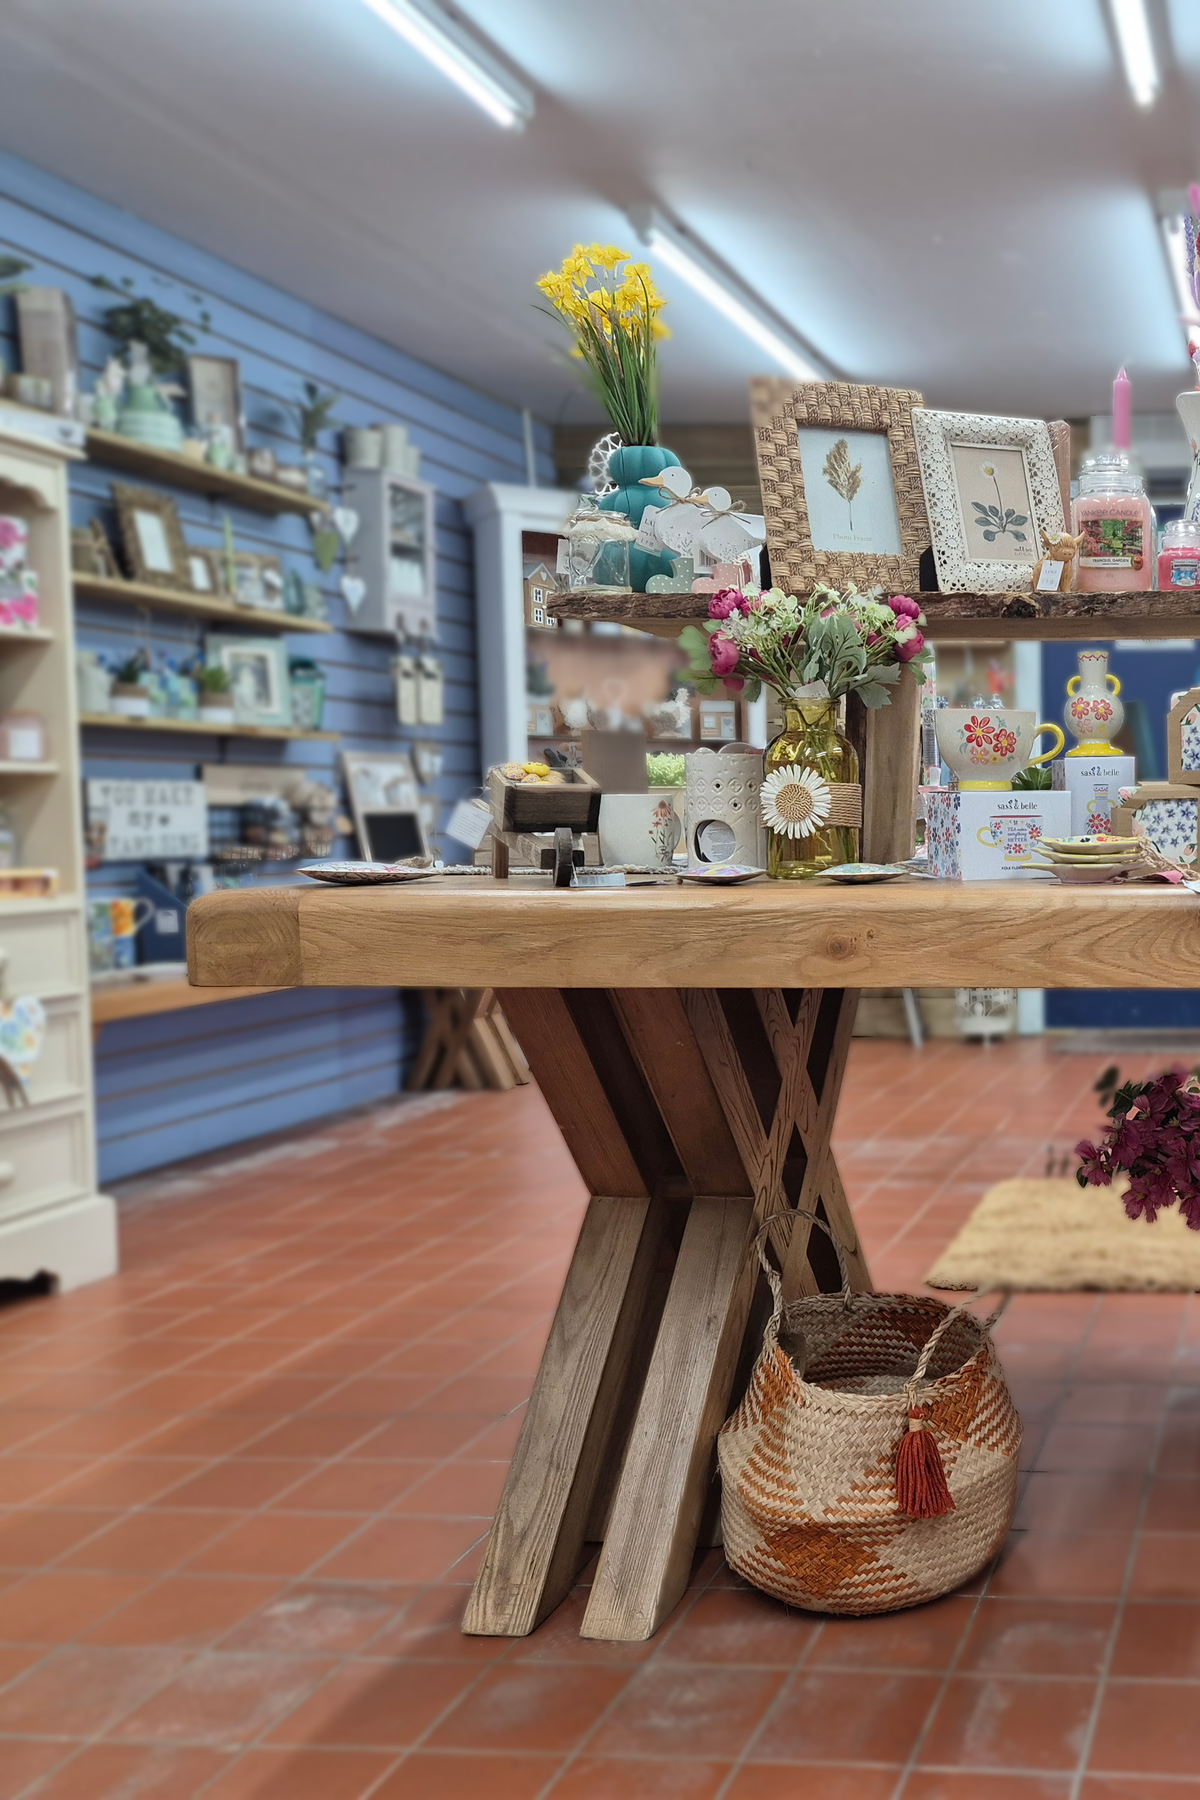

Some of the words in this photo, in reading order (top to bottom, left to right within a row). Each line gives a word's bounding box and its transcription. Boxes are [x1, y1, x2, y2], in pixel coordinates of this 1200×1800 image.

[1081, 509, 1108, 517] YANKEE
[1109, 508, 1139, 517] CANDLE
[832, 533, 852, 541] Photo
[1103, 769, 1120, 777] belle
[997, 802, 1013, 810] sass
[1020, 802, 1038, 810] belle
